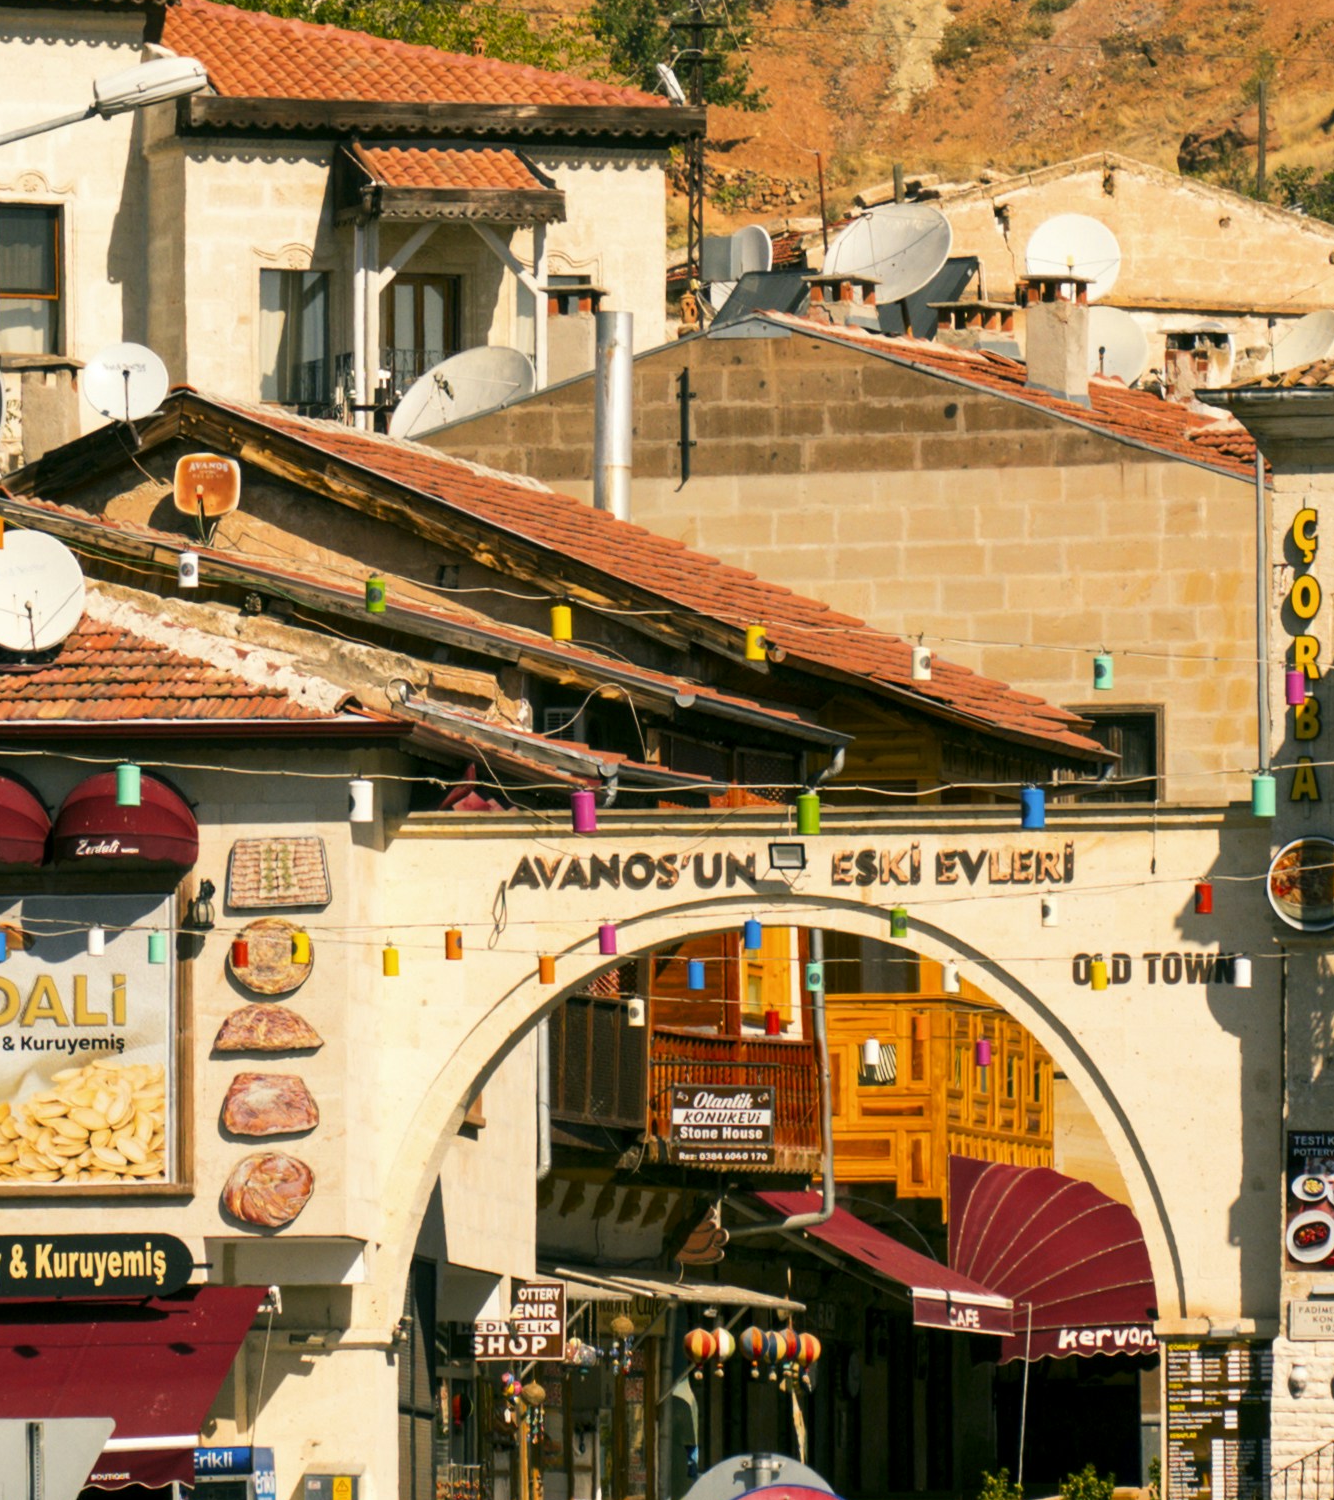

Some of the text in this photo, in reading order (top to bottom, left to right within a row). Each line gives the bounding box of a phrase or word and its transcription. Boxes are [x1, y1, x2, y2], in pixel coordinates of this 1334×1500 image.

[508, 840, 1075, 890] AVANOS'UN ESKİ EVLERİ
[1072, 952, 1238, 986] OD TOWN
[2, 1036, 15, 1051] &
[21, 1034, 125, 1055] Kuruyemiş
[679, 1126, 764, 1140] Stone House
[1294, 1134, 1325, 1146] TESTİ
[9, 1244, 28, 1279] &
[35, 1242, 167, 1287] Kuruyemiş
[517, 1287, 561, 1301] OTTERY
[462, 1321, 554, 1333] HEDİELİK
[948, 1307, 981, 1329] CAFE
[470, 1335, 548, 1356] SHOP
[1058, 1327, 1156, 1350] kervan
[90, 1472, 131, 1482] BOUTIQUE
